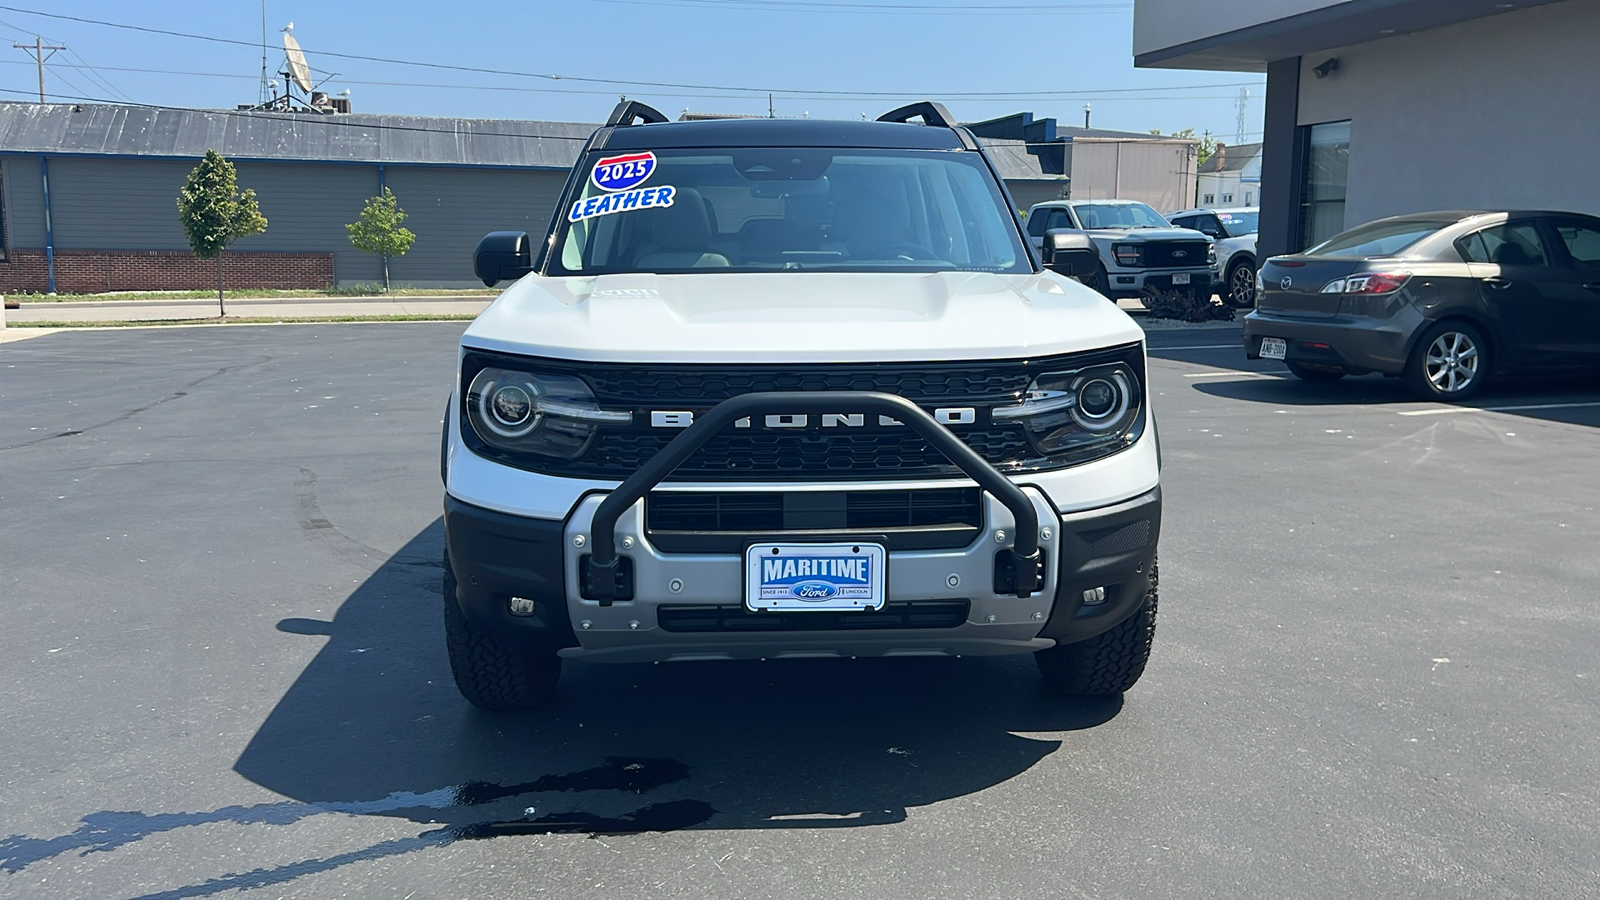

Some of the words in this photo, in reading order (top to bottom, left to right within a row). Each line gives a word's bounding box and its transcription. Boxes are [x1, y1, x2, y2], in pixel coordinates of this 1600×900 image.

[599, 160, 647, 183] 2025
[571, 187, 673, 220] LEATHER
[650, 407, 976, 428] BONO
[763, 558, 868, 583] MARITIME
[800, 585, 829, 598] Ford
